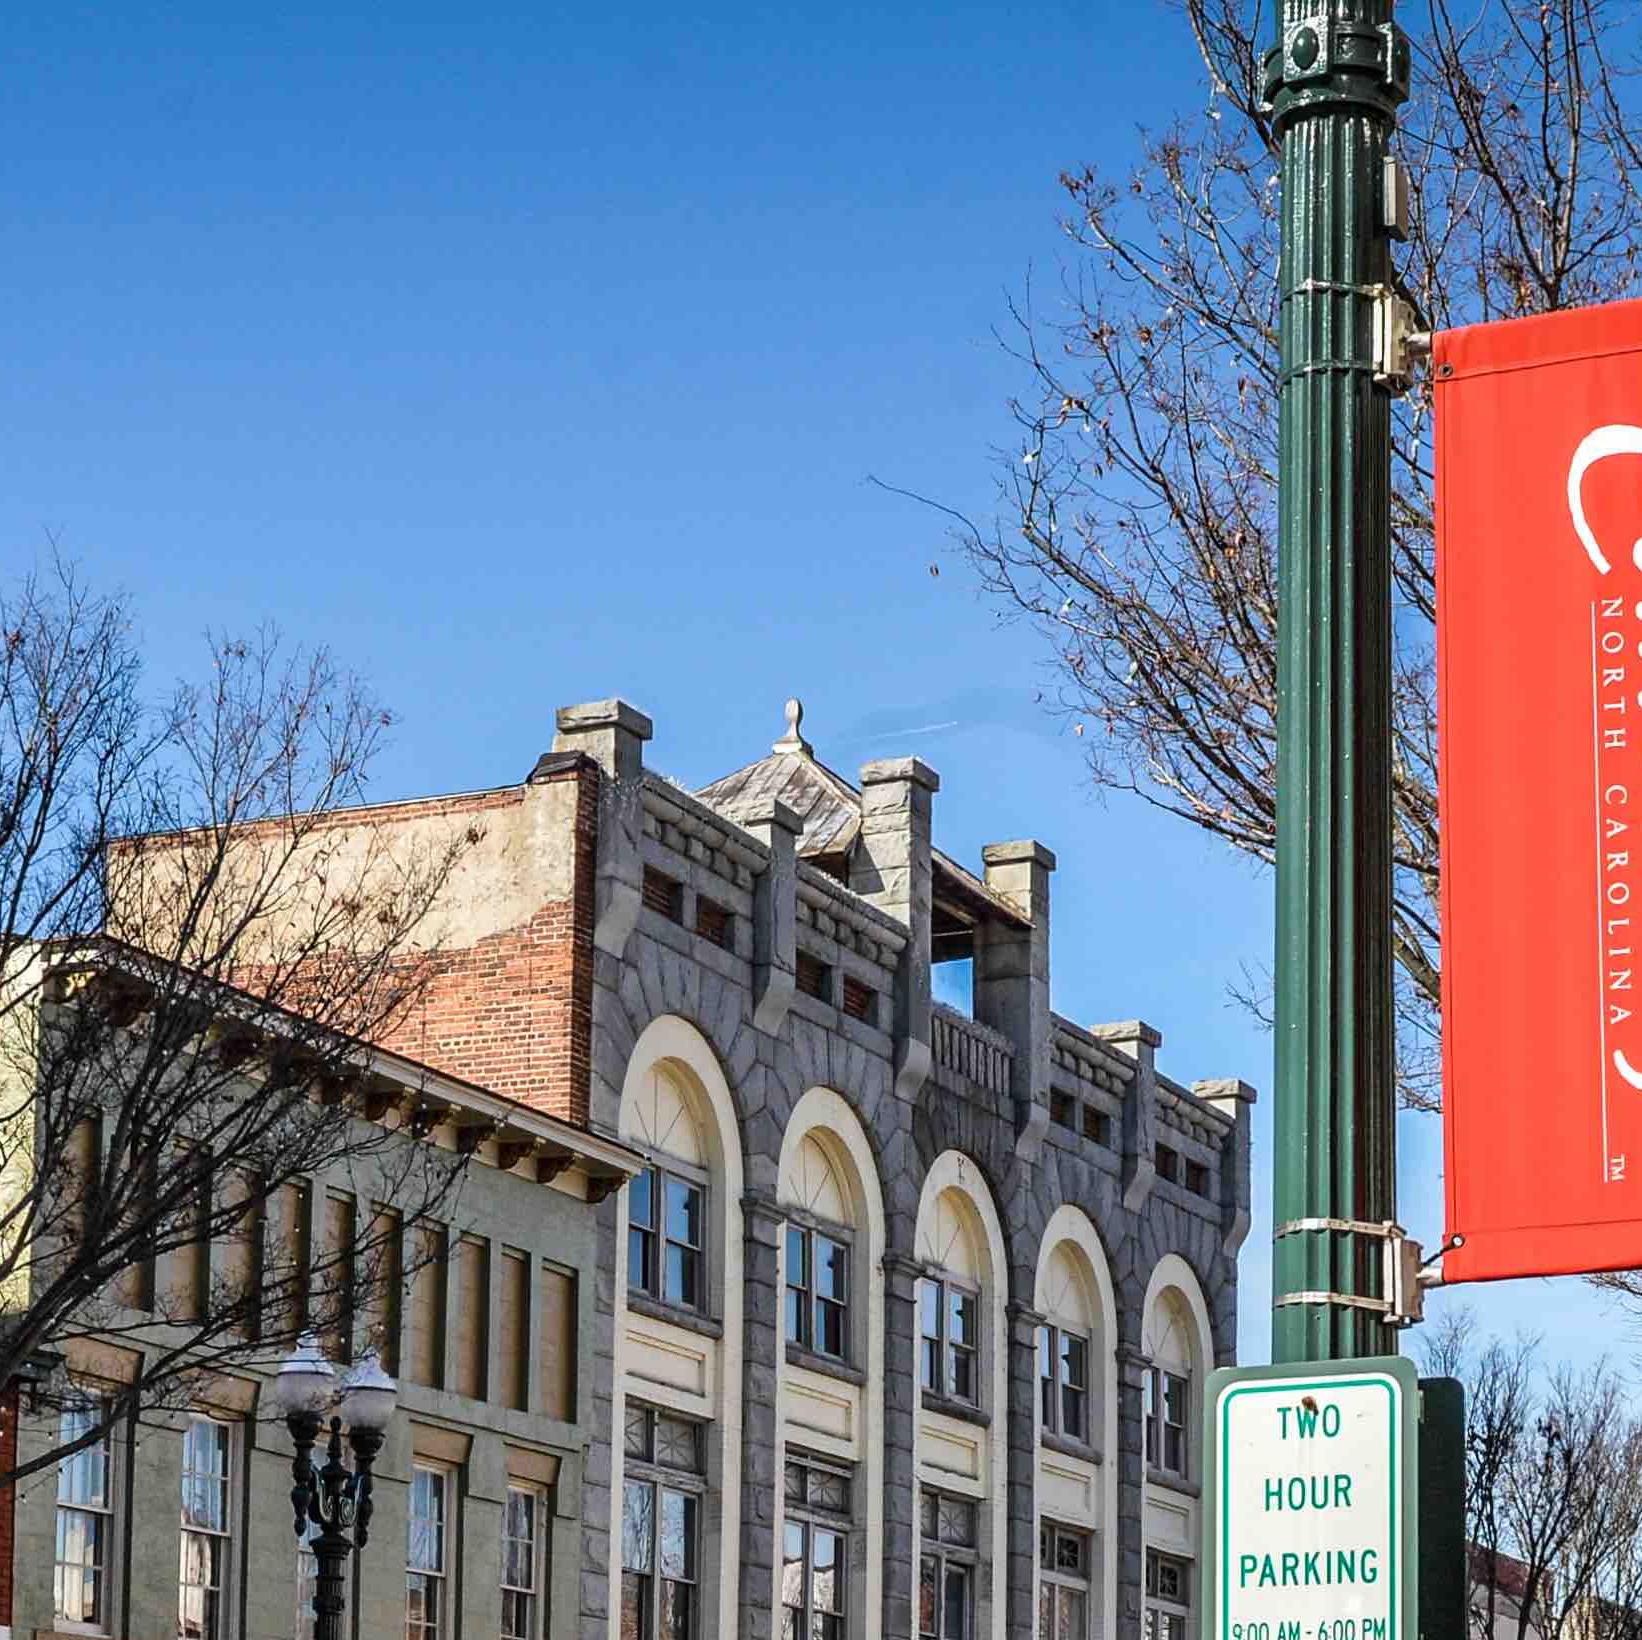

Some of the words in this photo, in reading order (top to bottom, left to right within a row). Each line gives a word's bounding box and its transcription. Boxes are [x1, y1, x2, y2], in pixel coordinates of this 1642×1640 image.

[1599, 596, 1627, 749] NORTH
[1604, 783, 1633, 1025] CAROLINA
[1276, 1403, 1341, 1440] TWO
[1264, 1474, 1352, 1511] HOUR
[1239, 1549, 1378, 1588] PARKING
